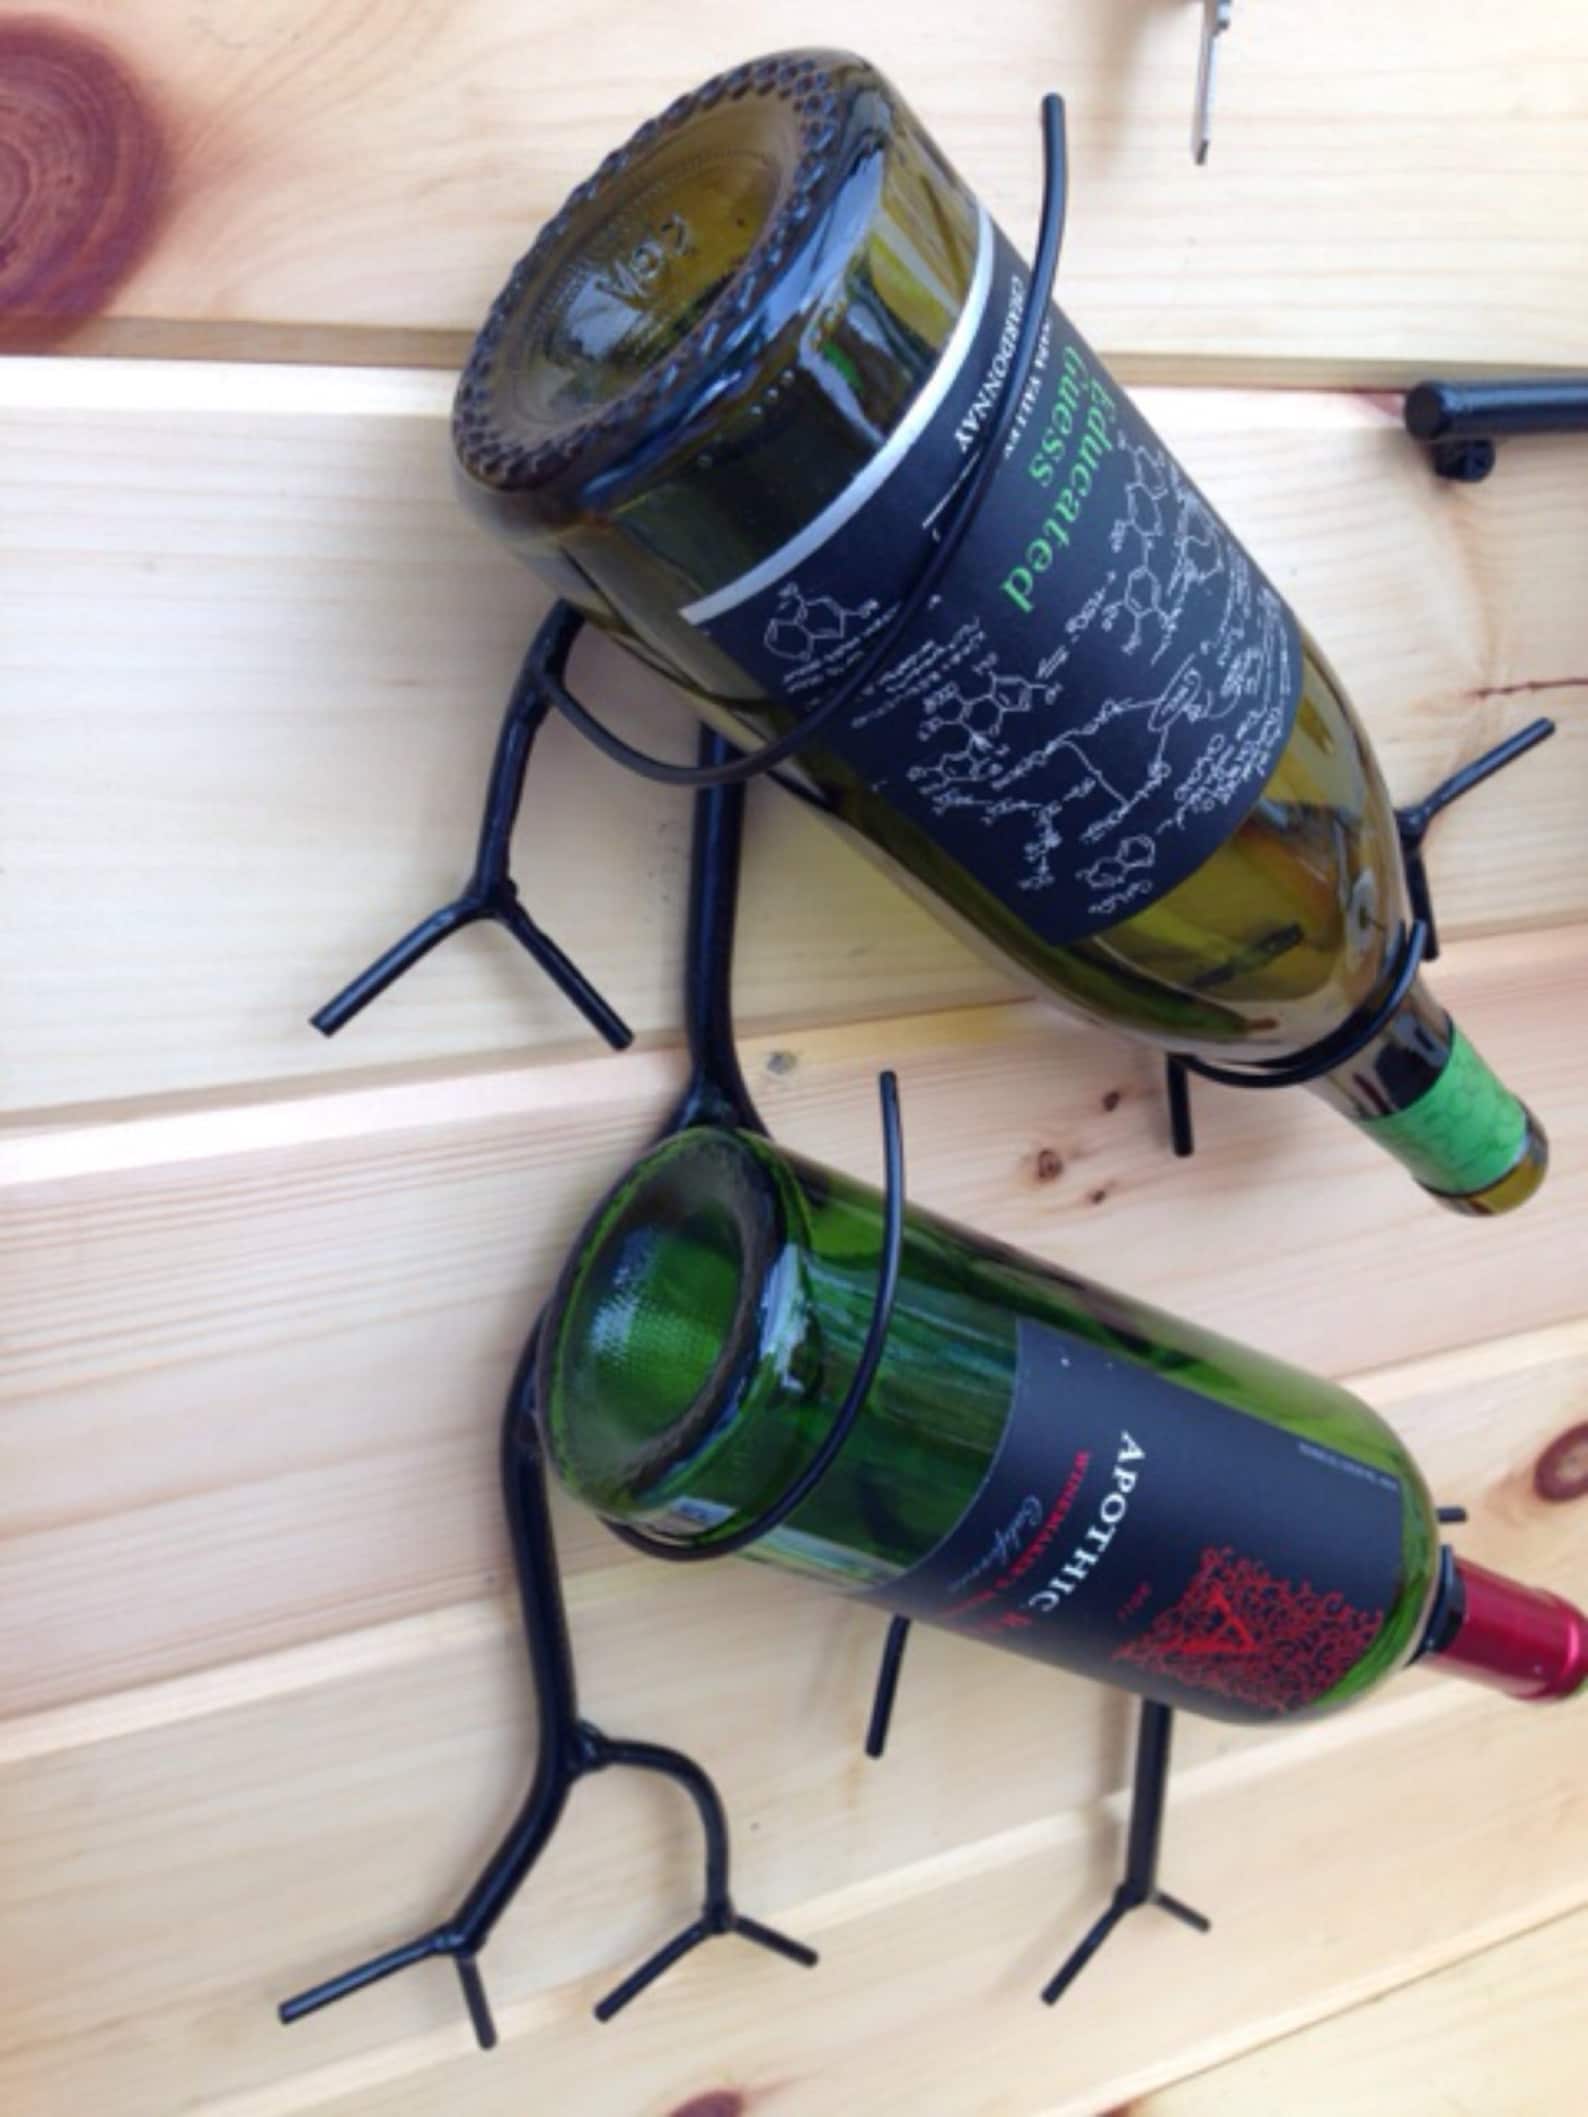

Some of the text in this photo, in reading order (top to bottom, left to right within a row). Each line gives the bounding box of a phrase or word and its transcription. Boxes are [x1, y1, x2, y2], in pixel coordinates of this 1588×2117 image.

[954, 272, 1025, 454] CHARDONNAY
[1027, 344, 1090, 488] Guess
[1000, 376, 1119, 614] Educated
[1028, 1429, 1147, 1614] APOTHIC
